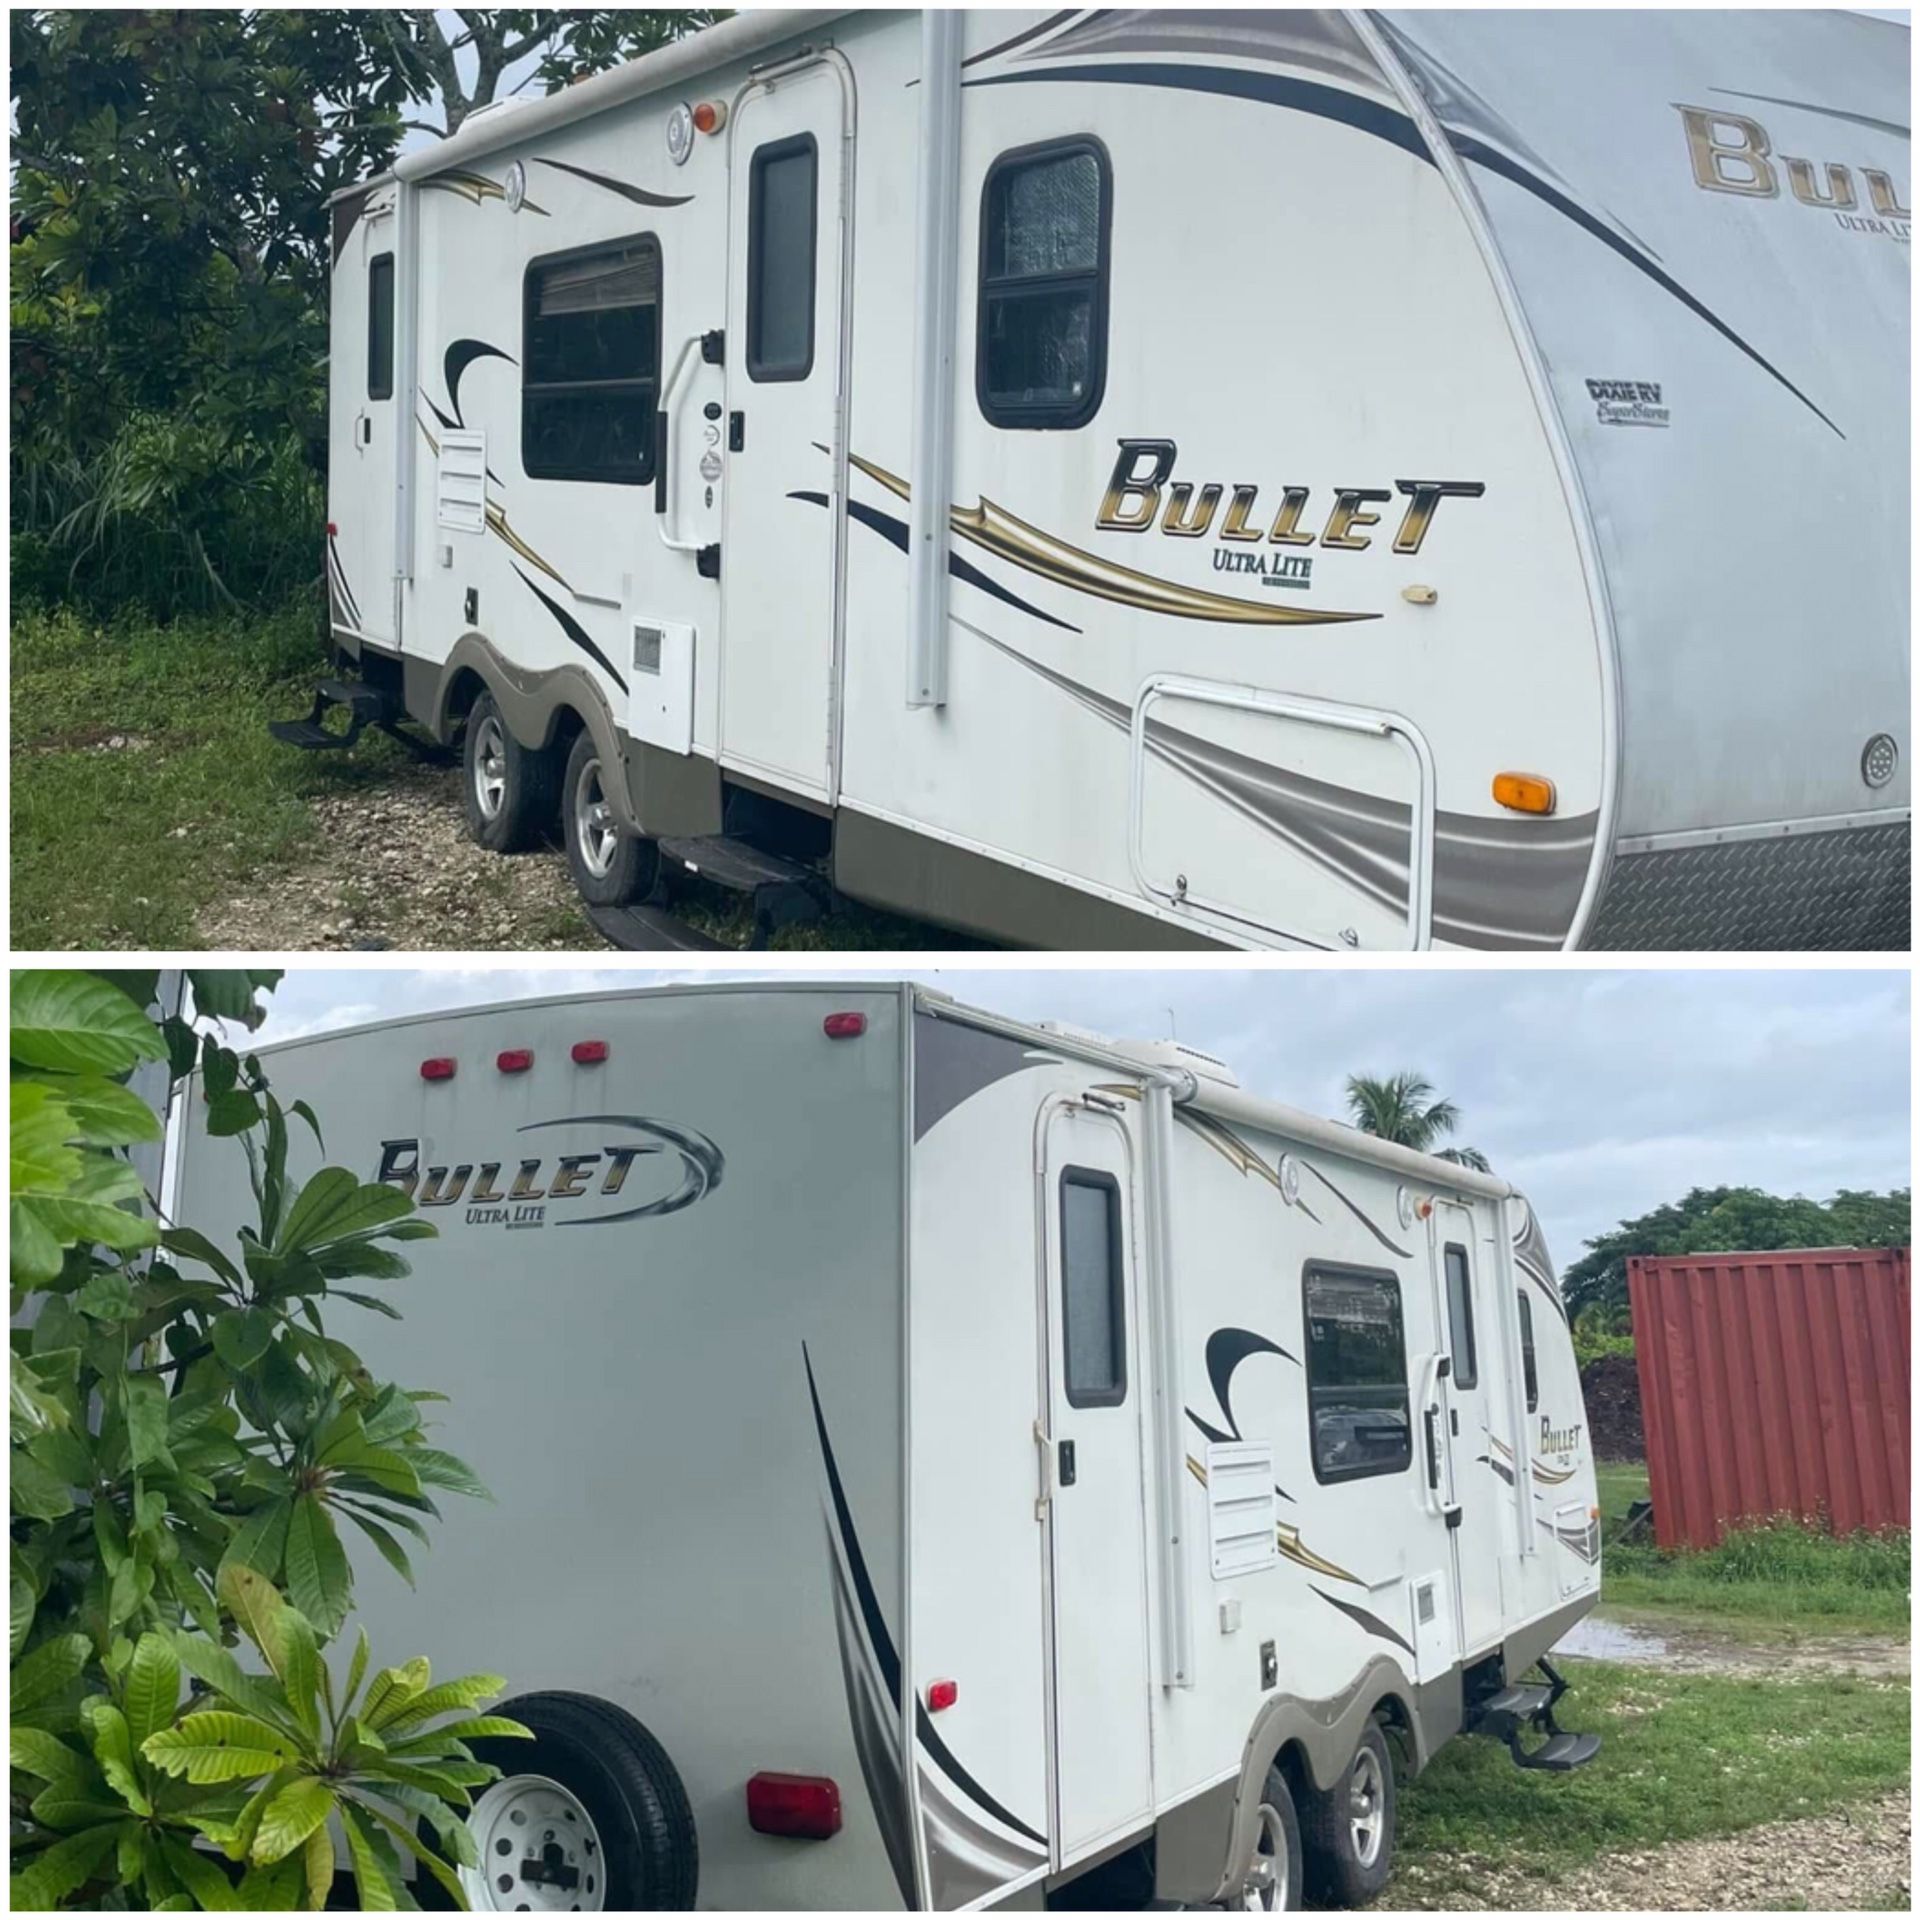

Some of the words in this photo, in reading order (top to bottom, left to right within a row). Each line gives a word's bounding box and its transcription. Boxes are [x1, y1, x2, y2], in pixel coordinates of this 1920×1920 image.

[1834, 213, 1892, 236] ULTRA
[1636, 382, 1662, 404] RV
[1096, 438, 1486, 555] BULLET
[1213, 548, 1267, 574] ULTRA
[1271, 553, 1313, 578] LITE
[465, 1208, 509, 1225] ULTRA
[514, 1205, 546, 1222] LITE
[1540, 1415, 1582, 1454] BULLET
